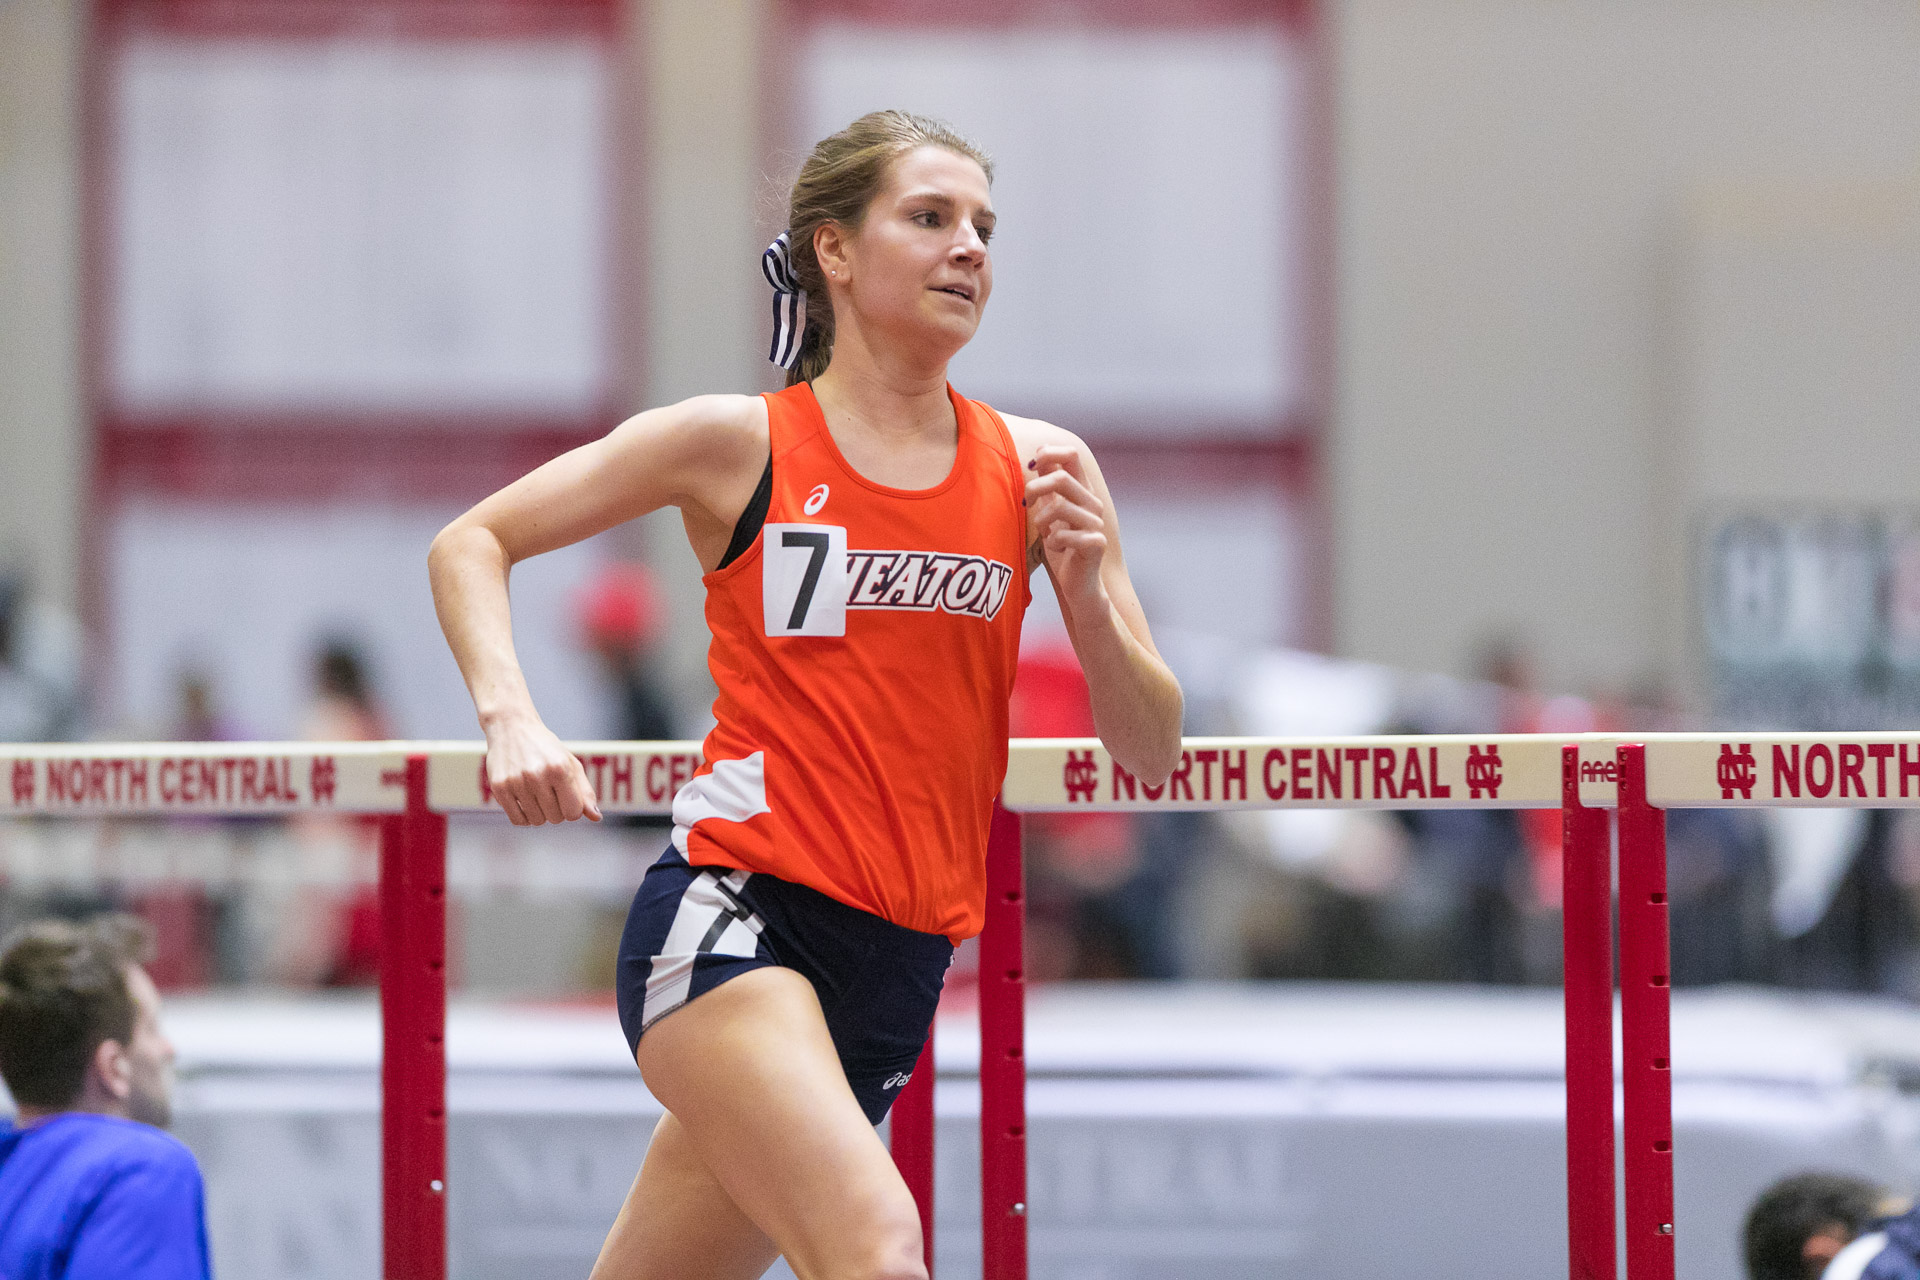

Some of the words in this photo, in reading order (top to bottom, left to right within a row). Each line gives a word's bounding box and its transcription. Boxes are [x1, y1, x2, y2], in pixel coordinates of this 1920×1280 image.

[782, 531, 829, 630] 7
[847, 552, 1013, 621] EATON
[47, 756, 147, 802] NORTH
[159, 756, 298, 802] CENTRAL
[1112, 749, 1248, 801] NRTH
[1262, 746, 1451, 800] CENTRAL
[1772, 743, 1920, 798] NORTH
